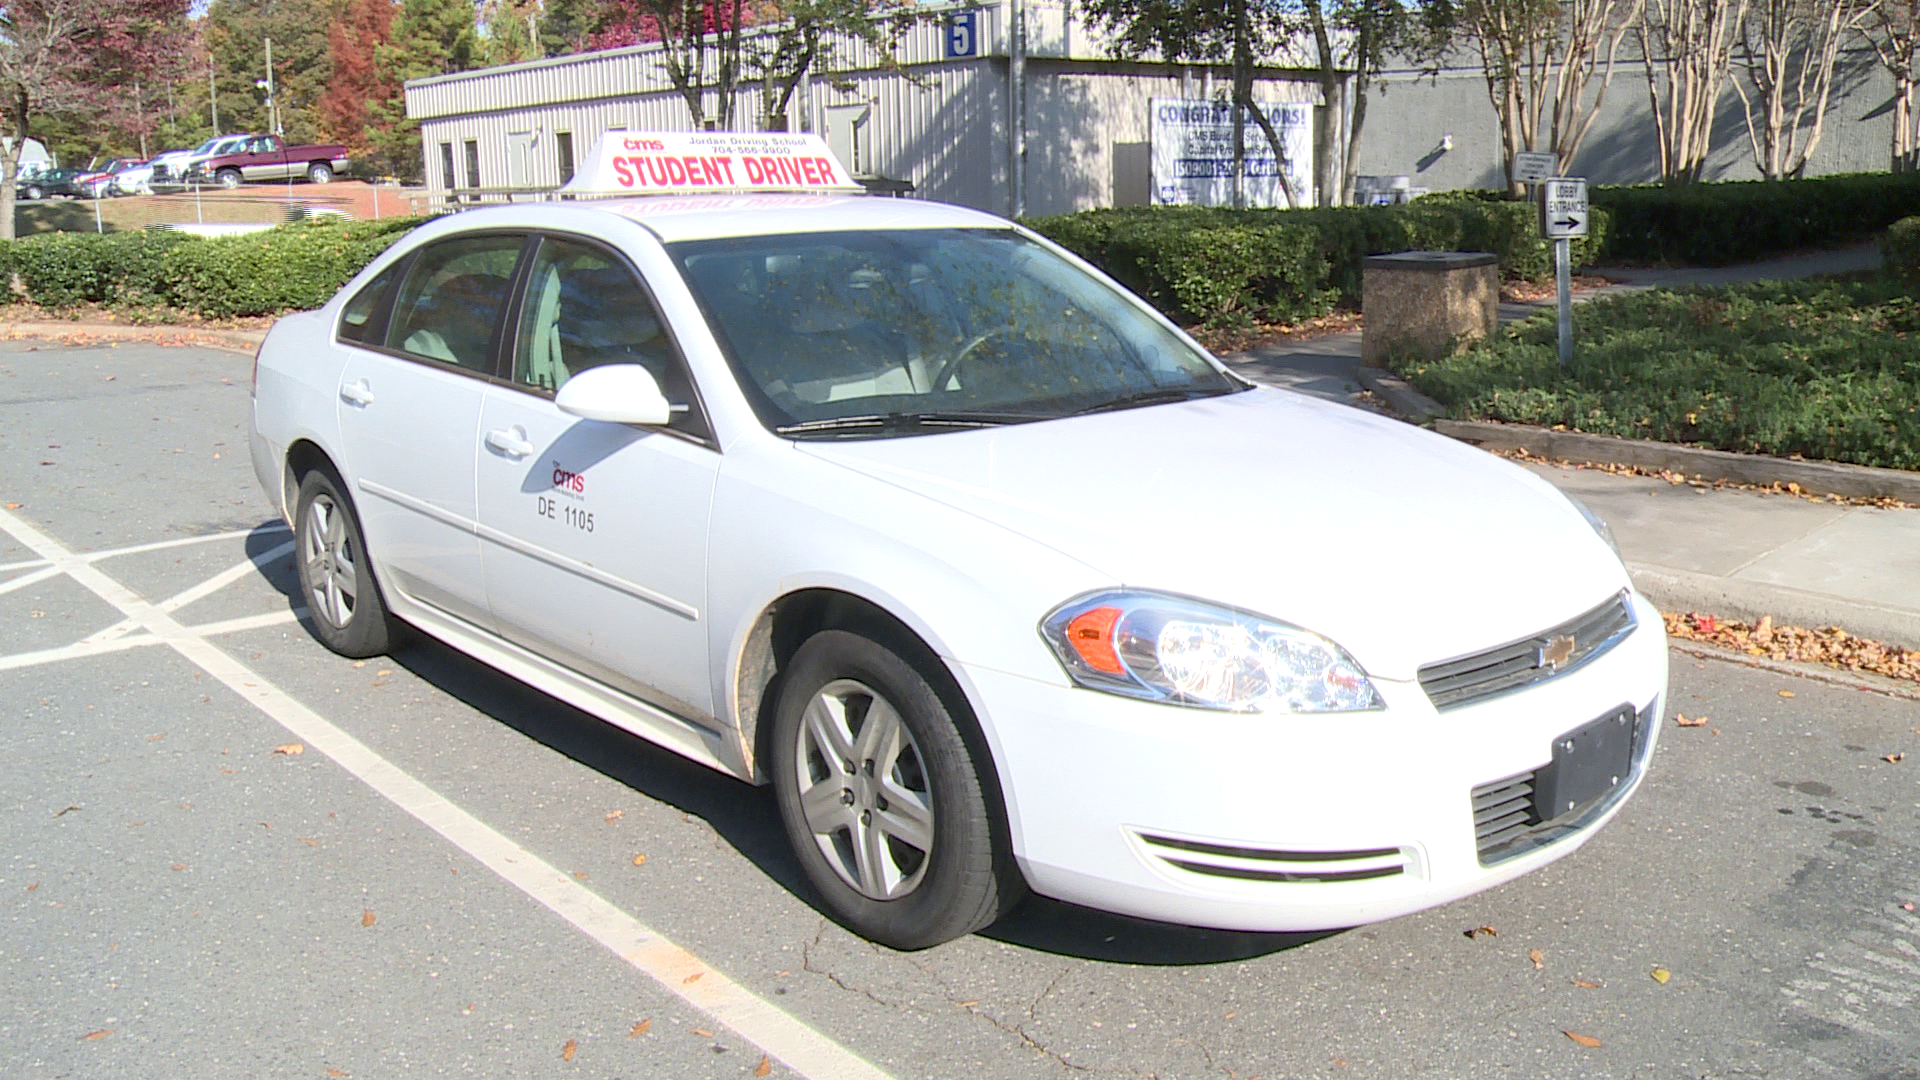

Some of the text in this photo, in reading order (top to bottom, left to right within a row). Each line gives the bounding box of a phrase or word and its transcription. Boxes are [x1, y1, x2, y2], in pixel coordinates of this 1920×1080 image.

[953, 15, 969, 55] 5
[1159, 105, 1306, 125] CONGRATIONS!
[689, 136, 807, 147] Jordan Driving School
[1209, 131, 1243, 142] Build
[711, 145, 790, 155] 704-566-9900
[612, 156, 837, 187] STUDENT DRIVER
[1250, 160, 1292, 176] Certifd
[1555, 185, 1578, 198] LOBBY
[1549, 200, 1586, 213] ENTRANCE
[553, 468, 584, 493] cms
[538, 496, 594, 533] DE 1105
